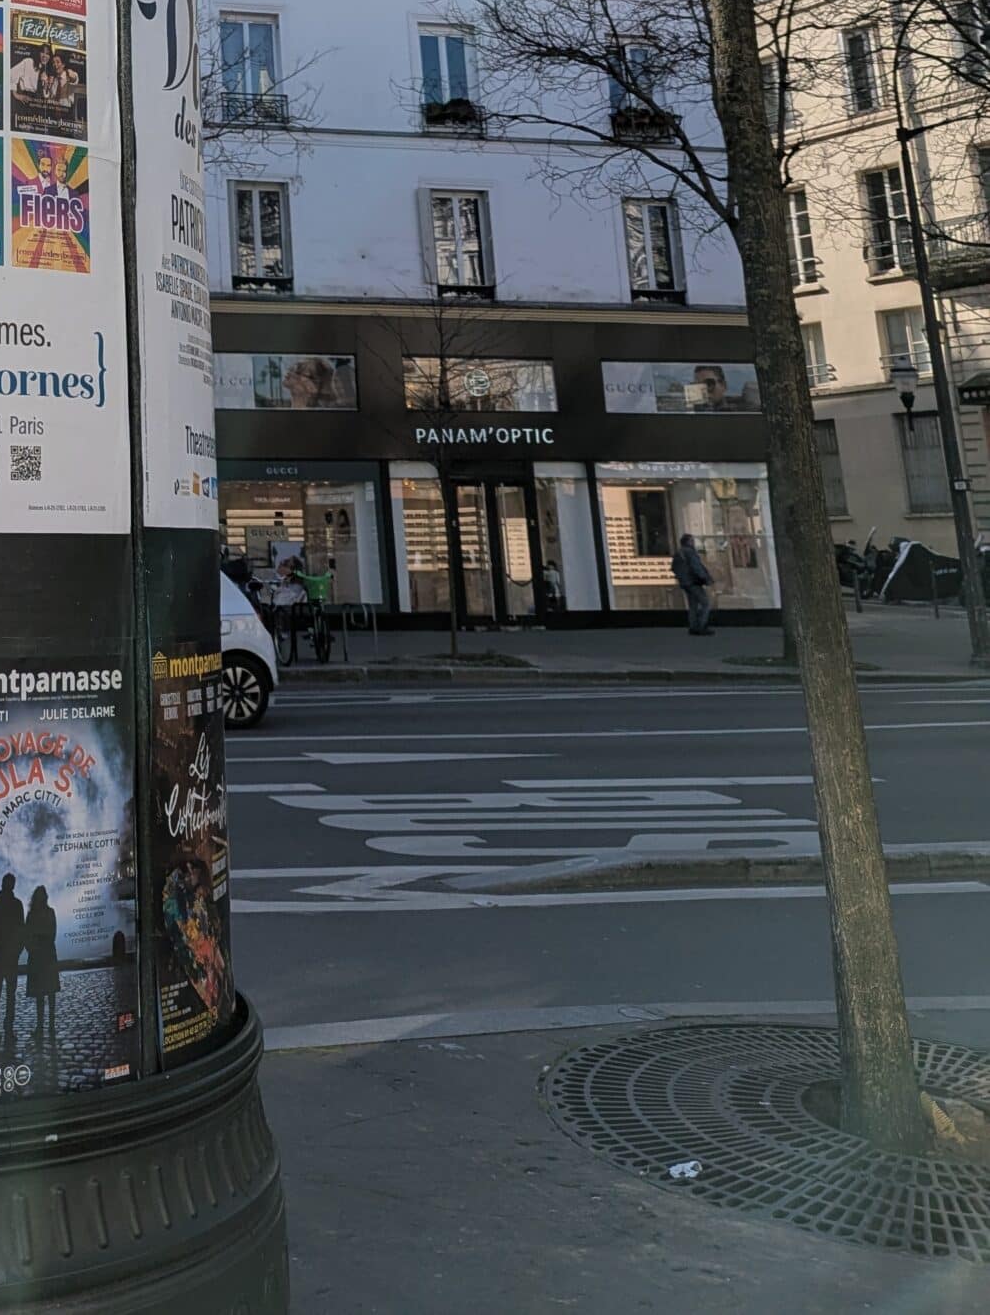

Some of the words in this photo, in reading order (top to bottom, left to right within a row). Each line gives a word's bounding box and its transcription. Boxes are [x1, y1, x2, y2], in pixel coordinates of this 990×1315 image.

[10, 416, 44, 436] Paris
[415, 427, 555, 444] PANAM'OPTIC
[266, 467, 298, 475] GUCCI
[39, 708, 68, 721] JULIE
[71, 706, 116, 719] DELARME
[69, 744, 96, 778] DE
[54, 764, 75, 798] S.
[3, 792, 30, 817] MARC
[34, 789, 62, 807] CITTI
[53, 840, 93, 852] STÉPHANE
[95, 838, 121, 848] COTTIN
